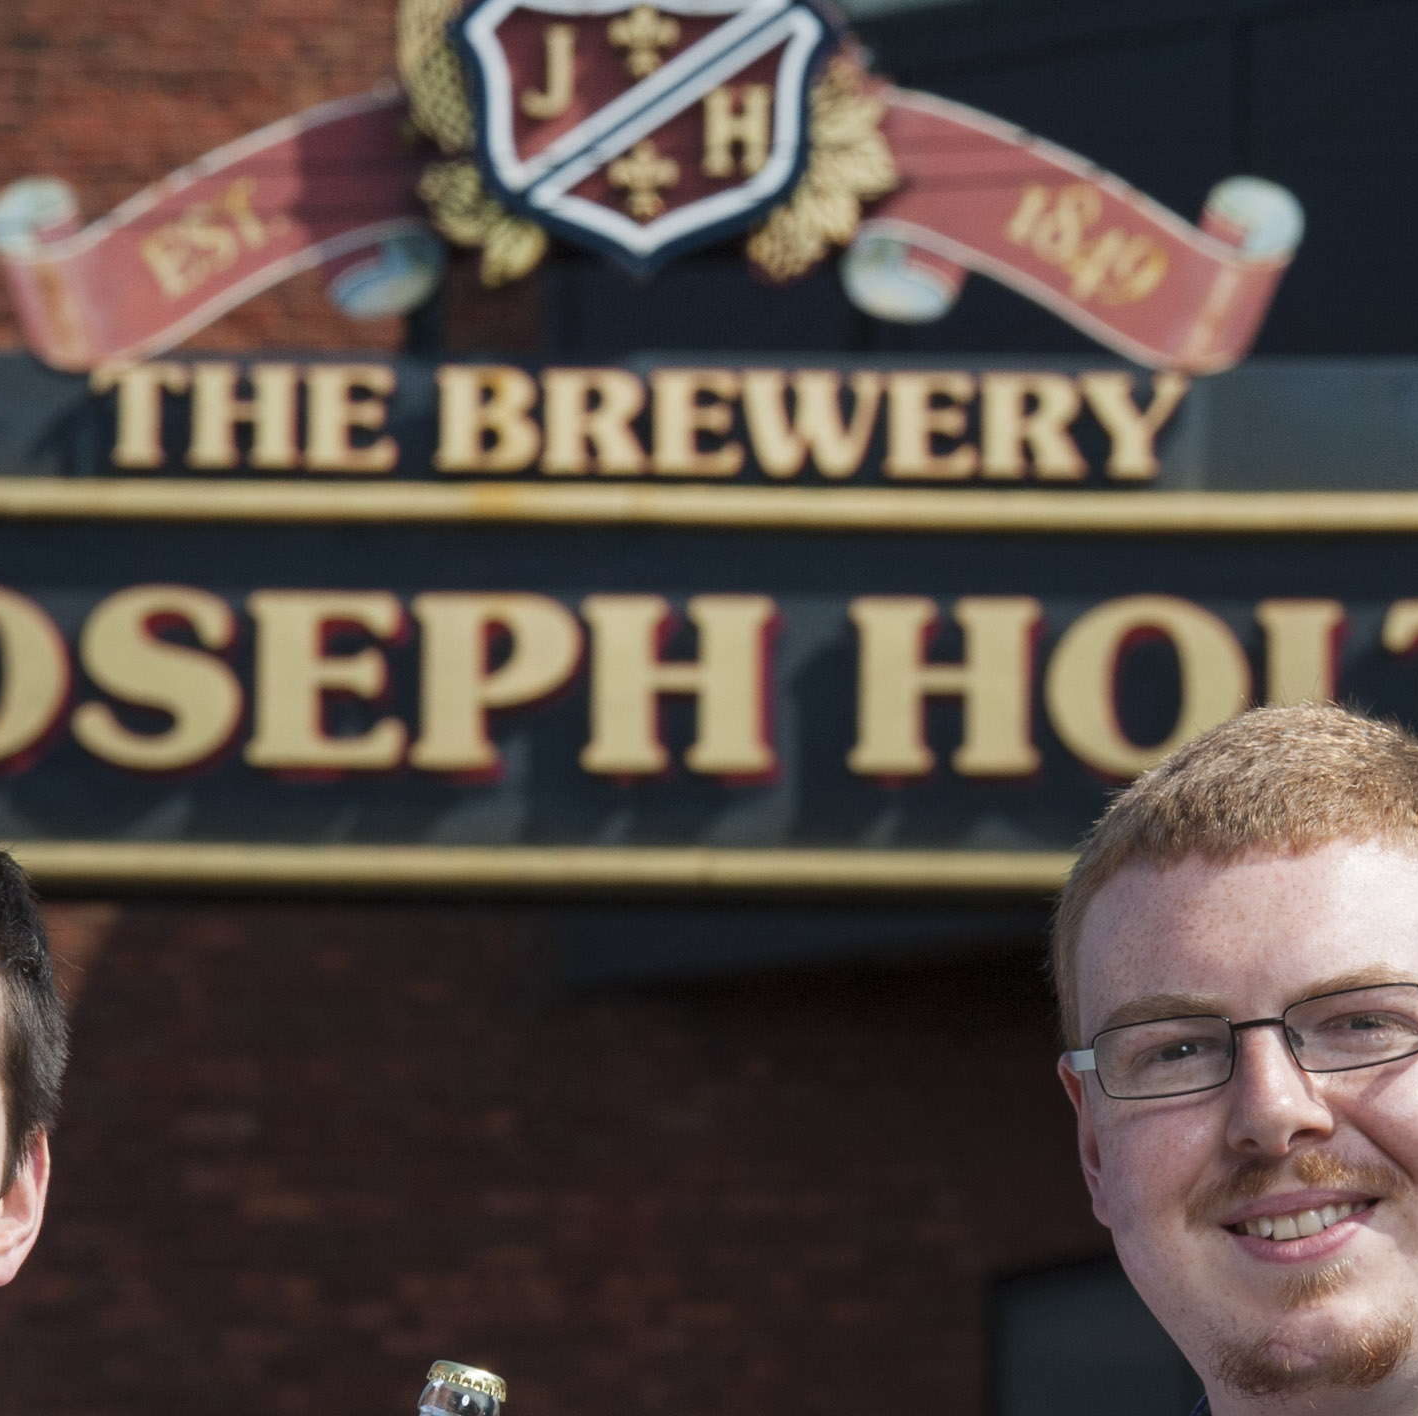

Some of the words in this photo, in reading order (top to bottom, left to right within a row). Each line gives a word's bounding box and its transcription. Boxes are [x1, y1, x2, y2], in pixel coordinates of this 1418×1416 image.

[520, 24, 577, 121] J
[702, 84, 775, 178] H
[1006, 181, 1169, 305] 1849
[93, 363, 399, 472] THE
[436, 364, 1187, 484] BREWERY
